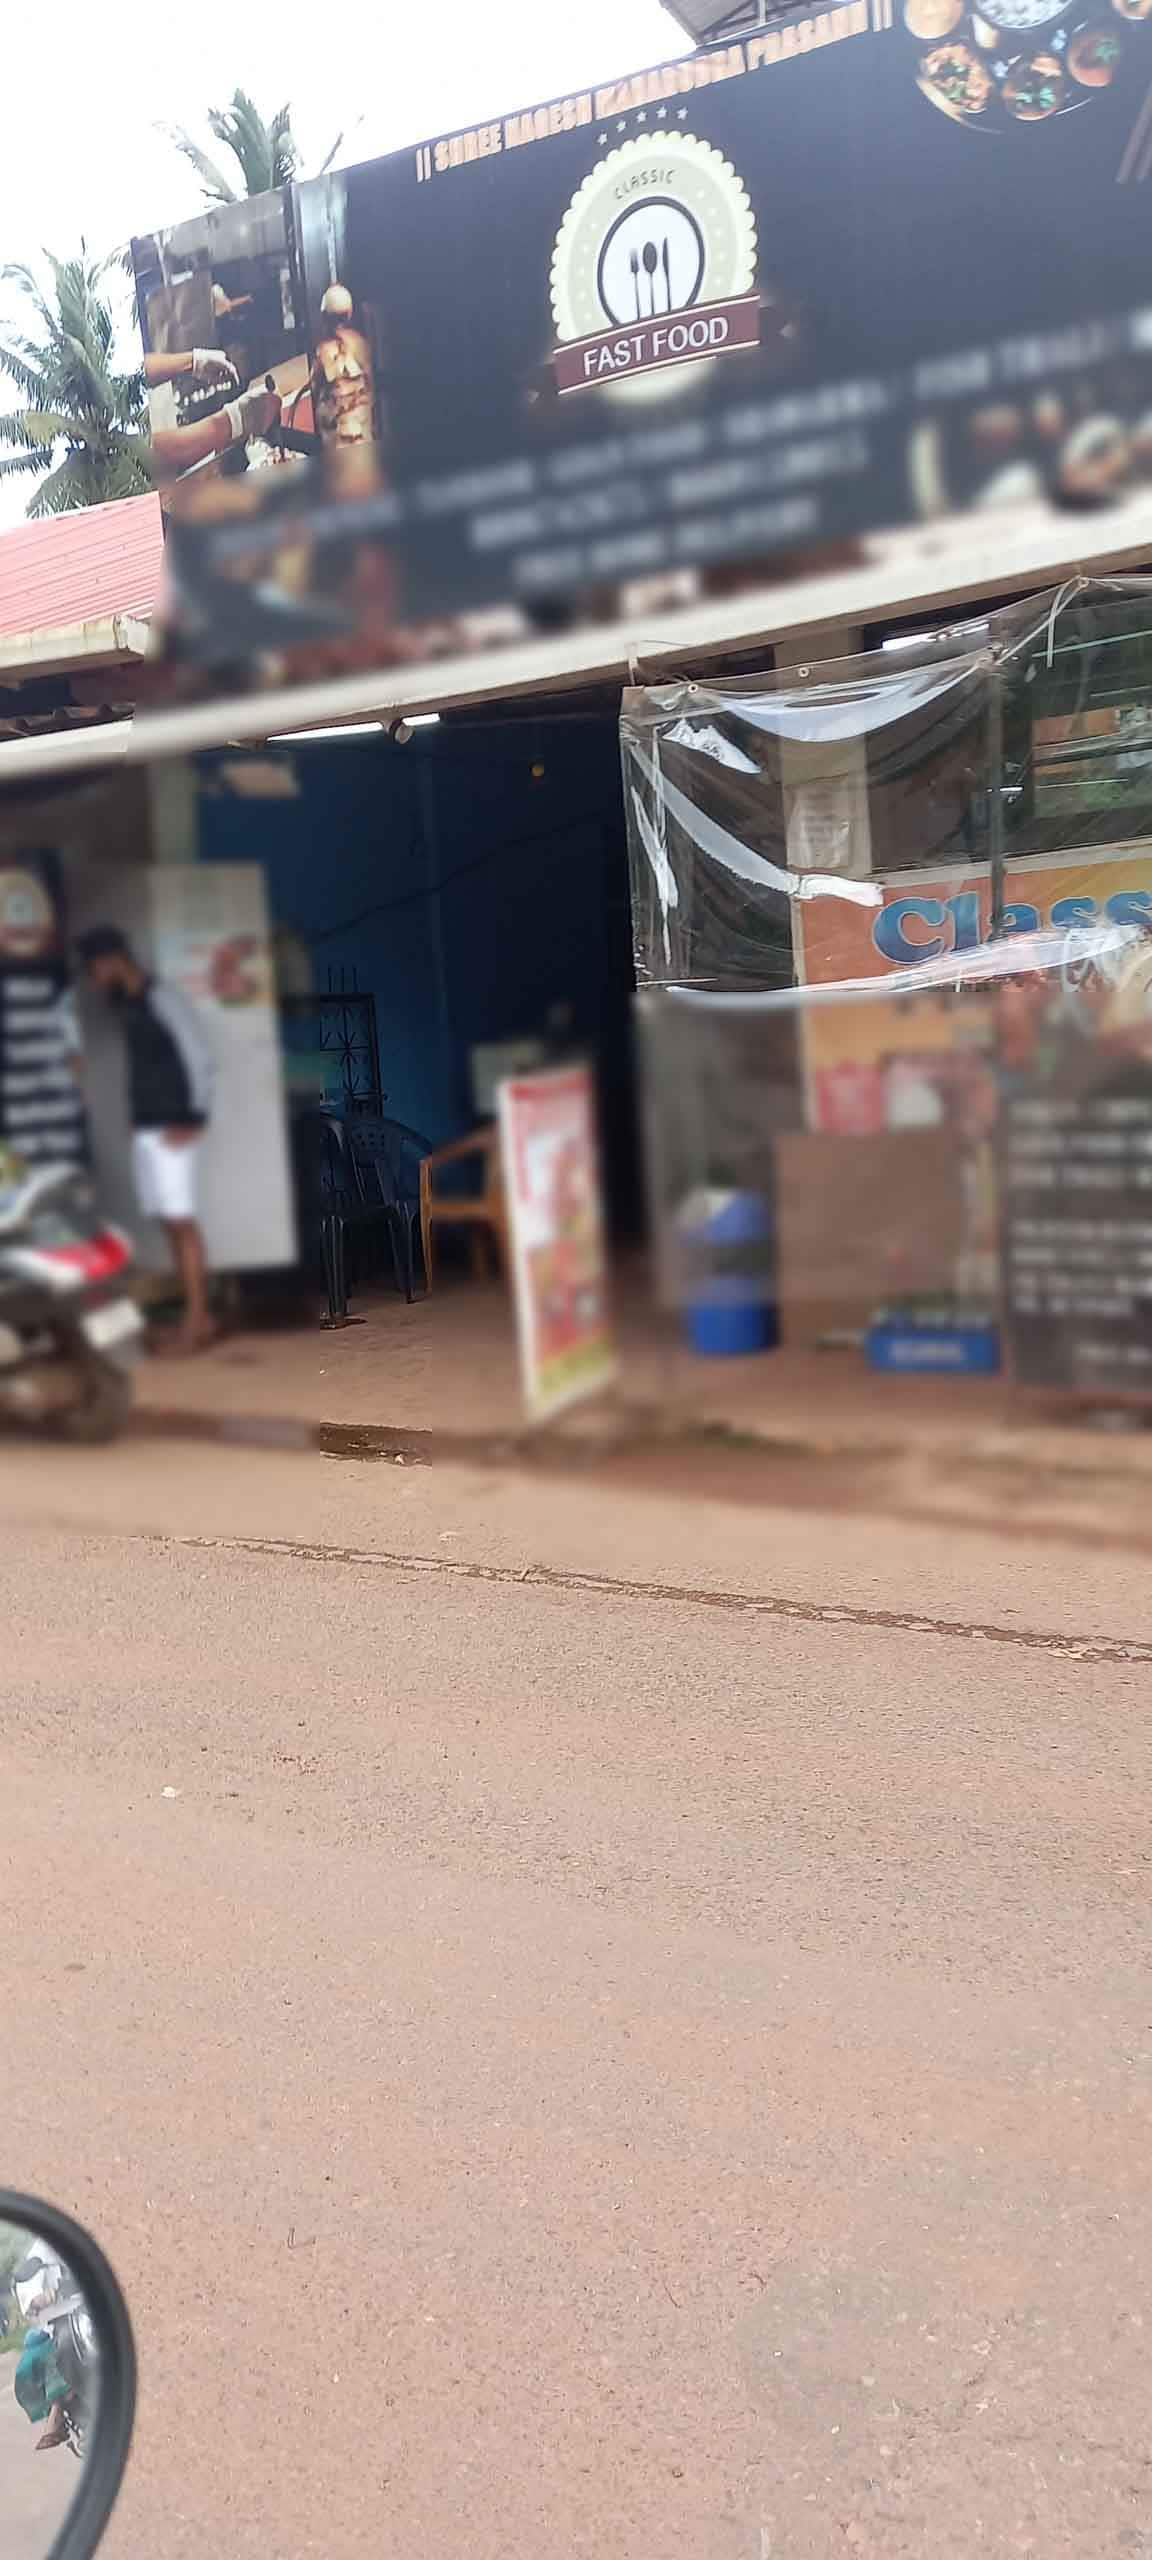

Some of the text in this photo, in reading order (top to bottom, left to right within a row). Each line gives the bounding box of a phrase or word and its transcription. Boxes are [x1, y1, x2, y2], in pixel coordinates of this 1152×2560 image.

[434, 122, 502, 172] SHREE
[504, 93, 593, 150] NAGESH
[615, 168, 676, 200] CLASSIC
[583, 316, 729, 376] FAST FOOD
